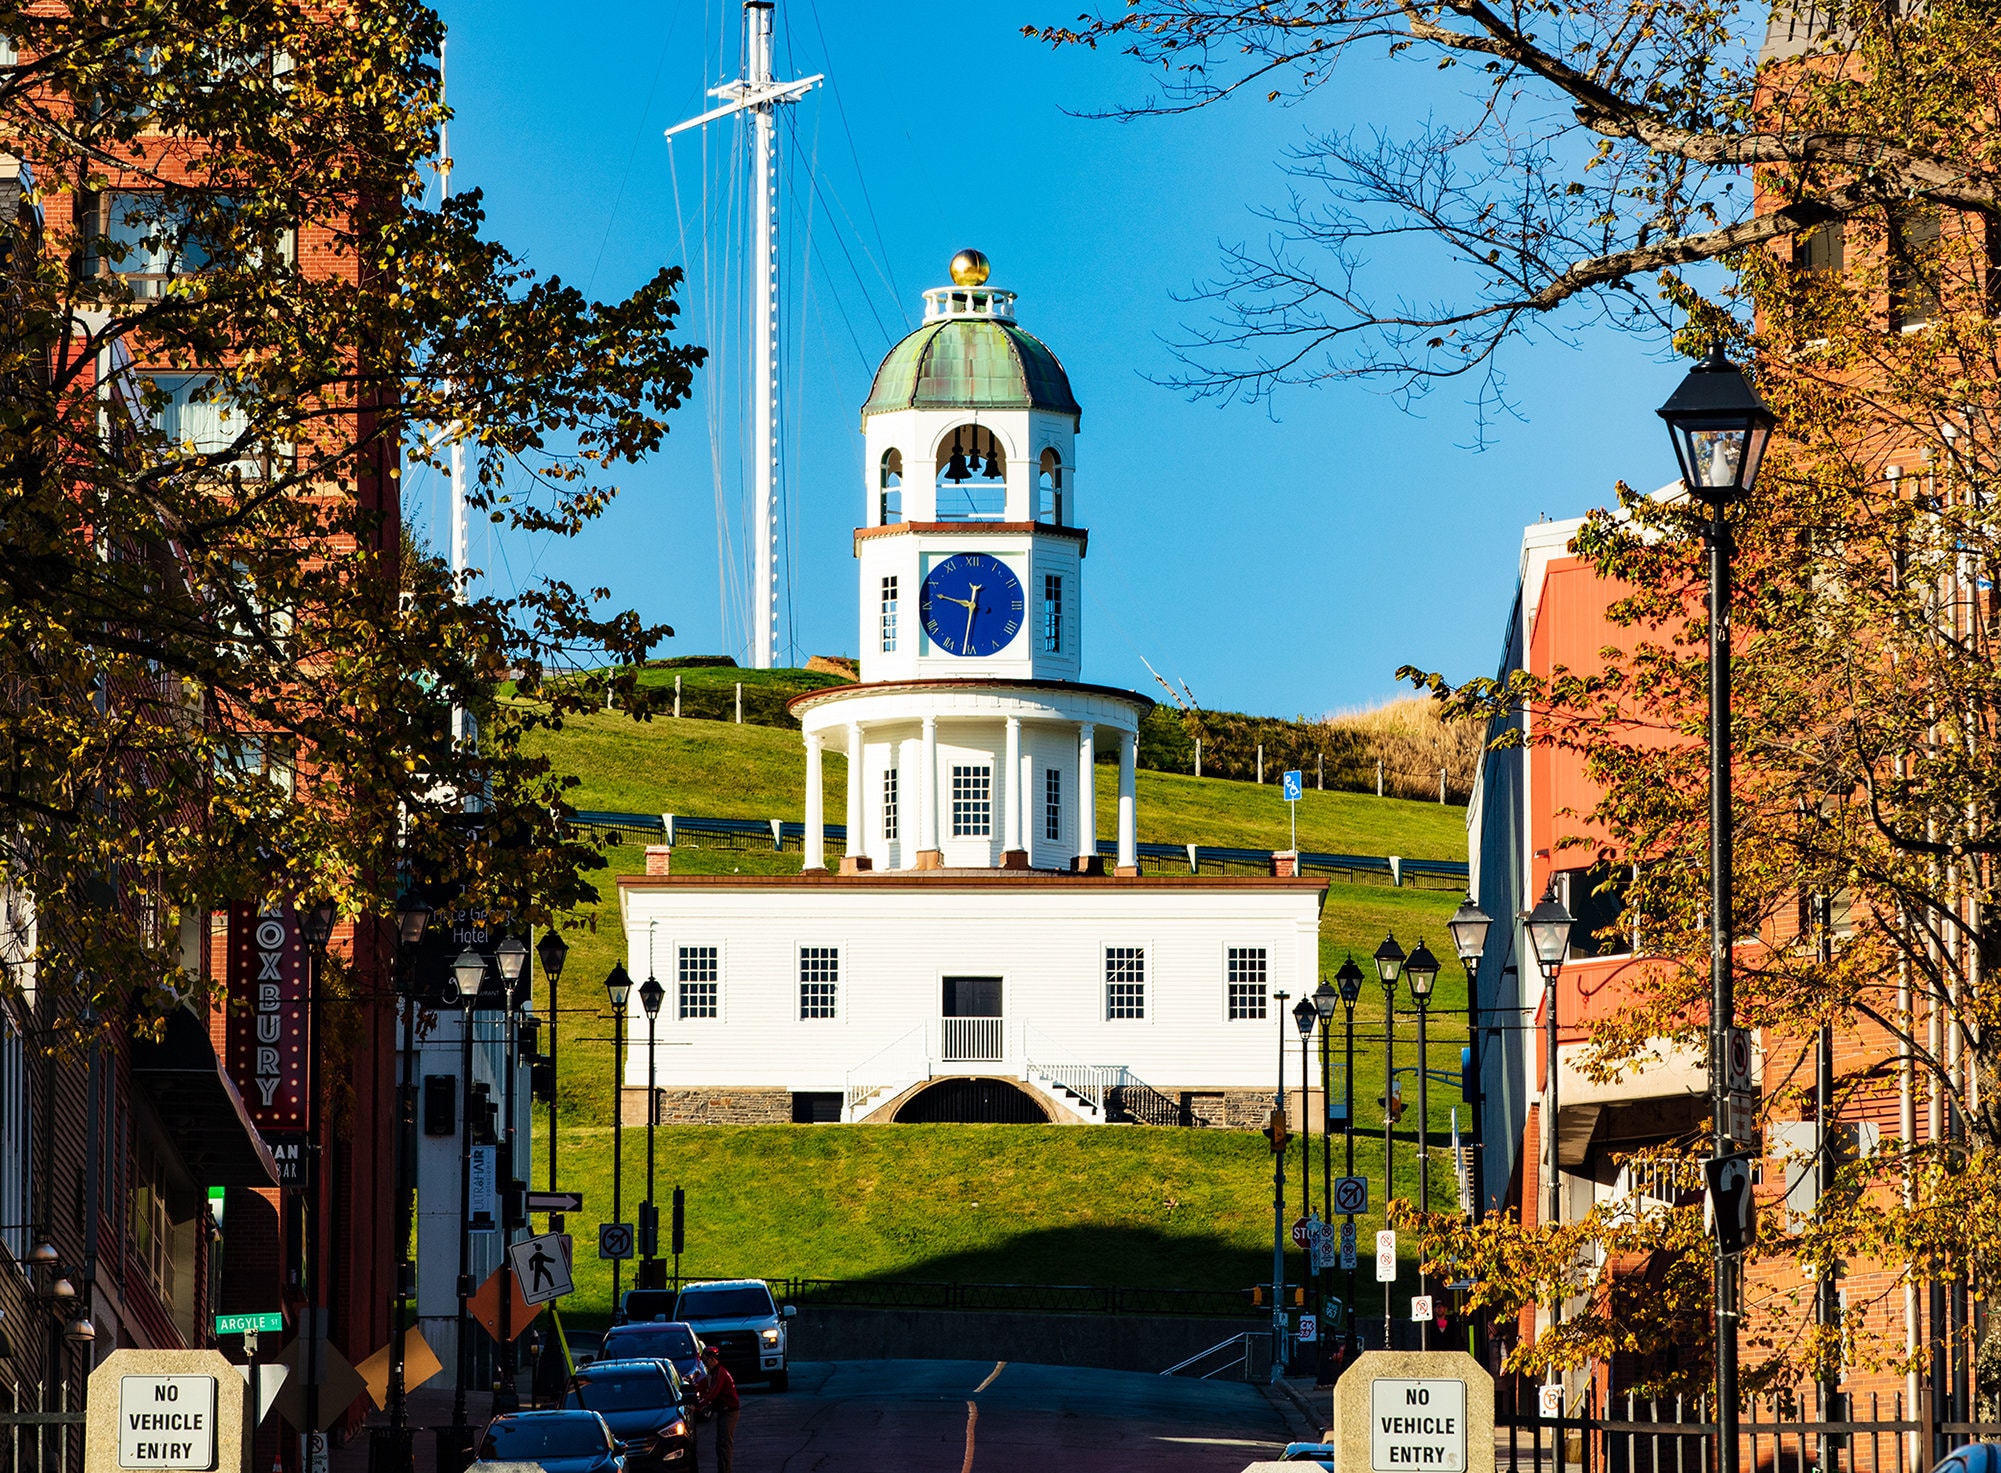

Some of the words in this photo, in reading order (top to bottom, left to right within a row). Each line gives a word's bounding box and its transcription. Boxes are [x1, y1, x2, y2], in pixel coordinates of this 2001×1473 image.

[943, 560, 957, 574] XI
[965, 557, 980, 567] XII
[453, 928, 489, 943] Hotel
[221, 1317, 266, 1330] ARGYLE
[155, 1385, 179, 1402] NO
[1406, 1389, 1430, 1405] NO
[129, 1413, 203, 1430] VEHICLE
[1381, 1417, 1455, 1434] VEHICLE
[1390, 1446, 1445, 1463] ENTRY
